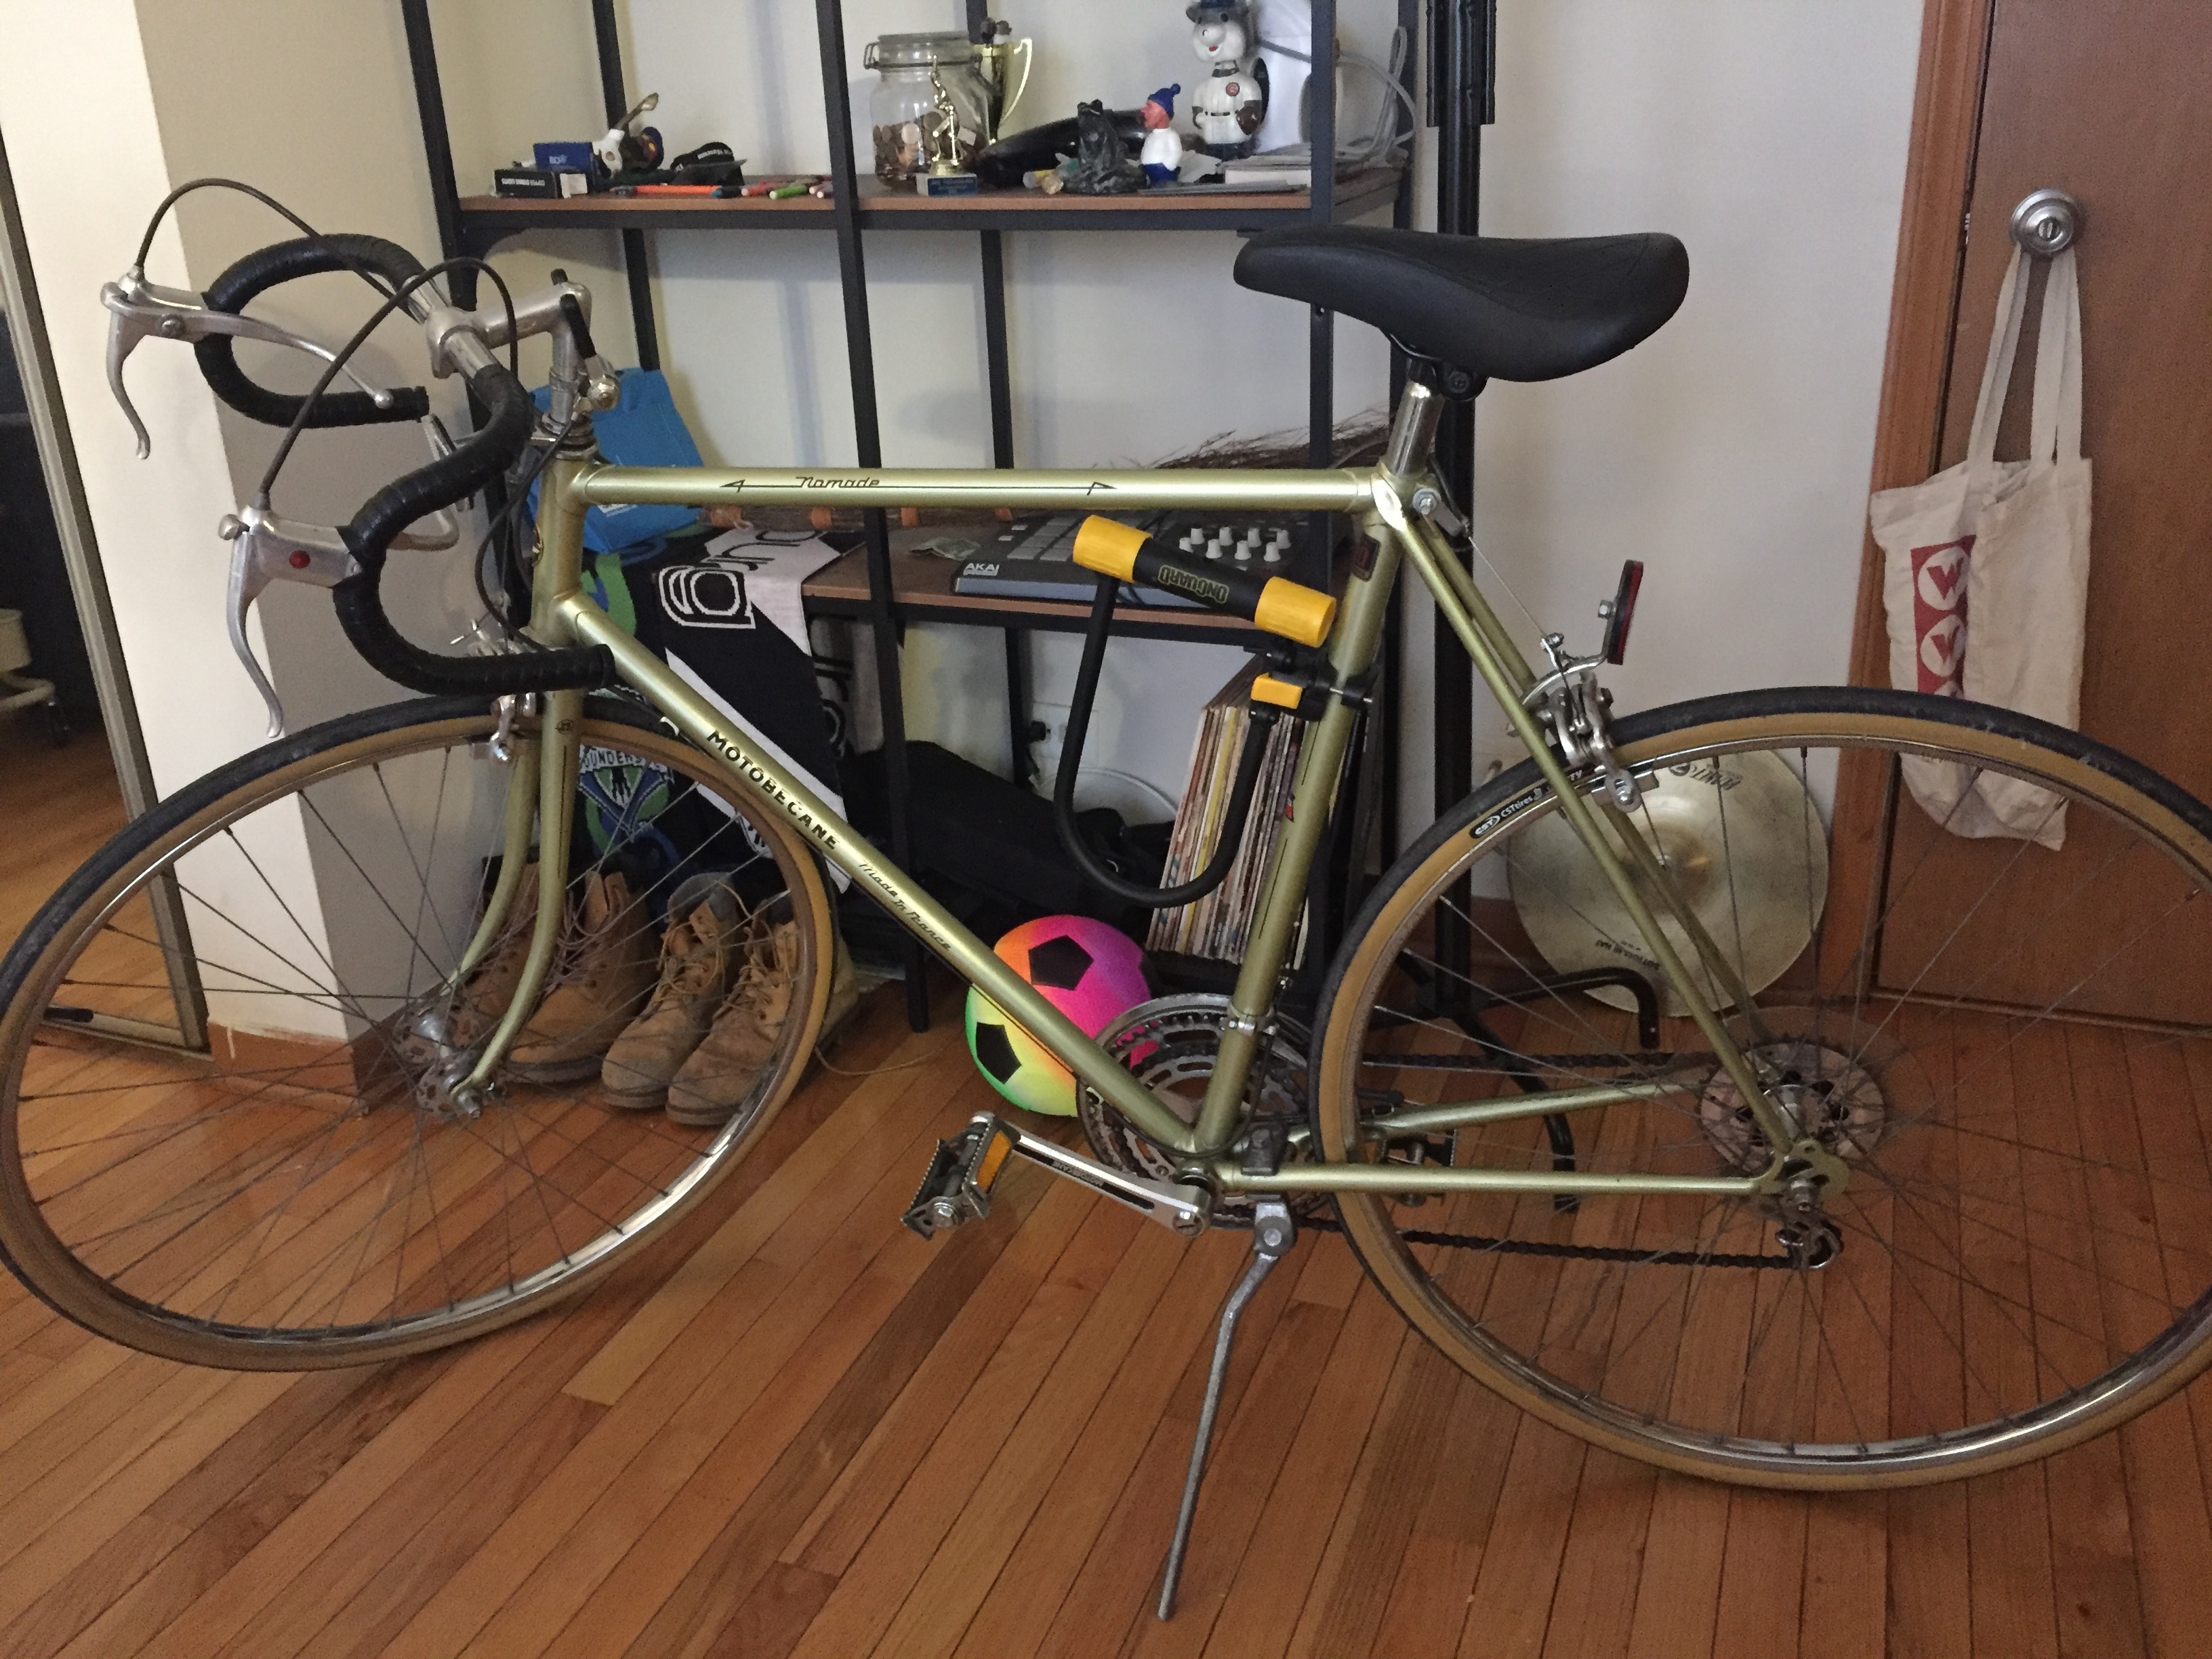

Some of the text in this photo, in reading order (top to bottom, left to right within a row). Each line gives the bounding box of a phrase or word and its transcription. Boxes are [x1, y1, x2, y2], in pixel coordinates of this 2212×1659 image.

[796, 476, 880, 488] Nomade
[964, 562, 1000, 571] AKAI
[707, 730, 840, 849] MOTOBECANE
[859, 863, 898, 897] Made
[906, 911, 951, 950] France
